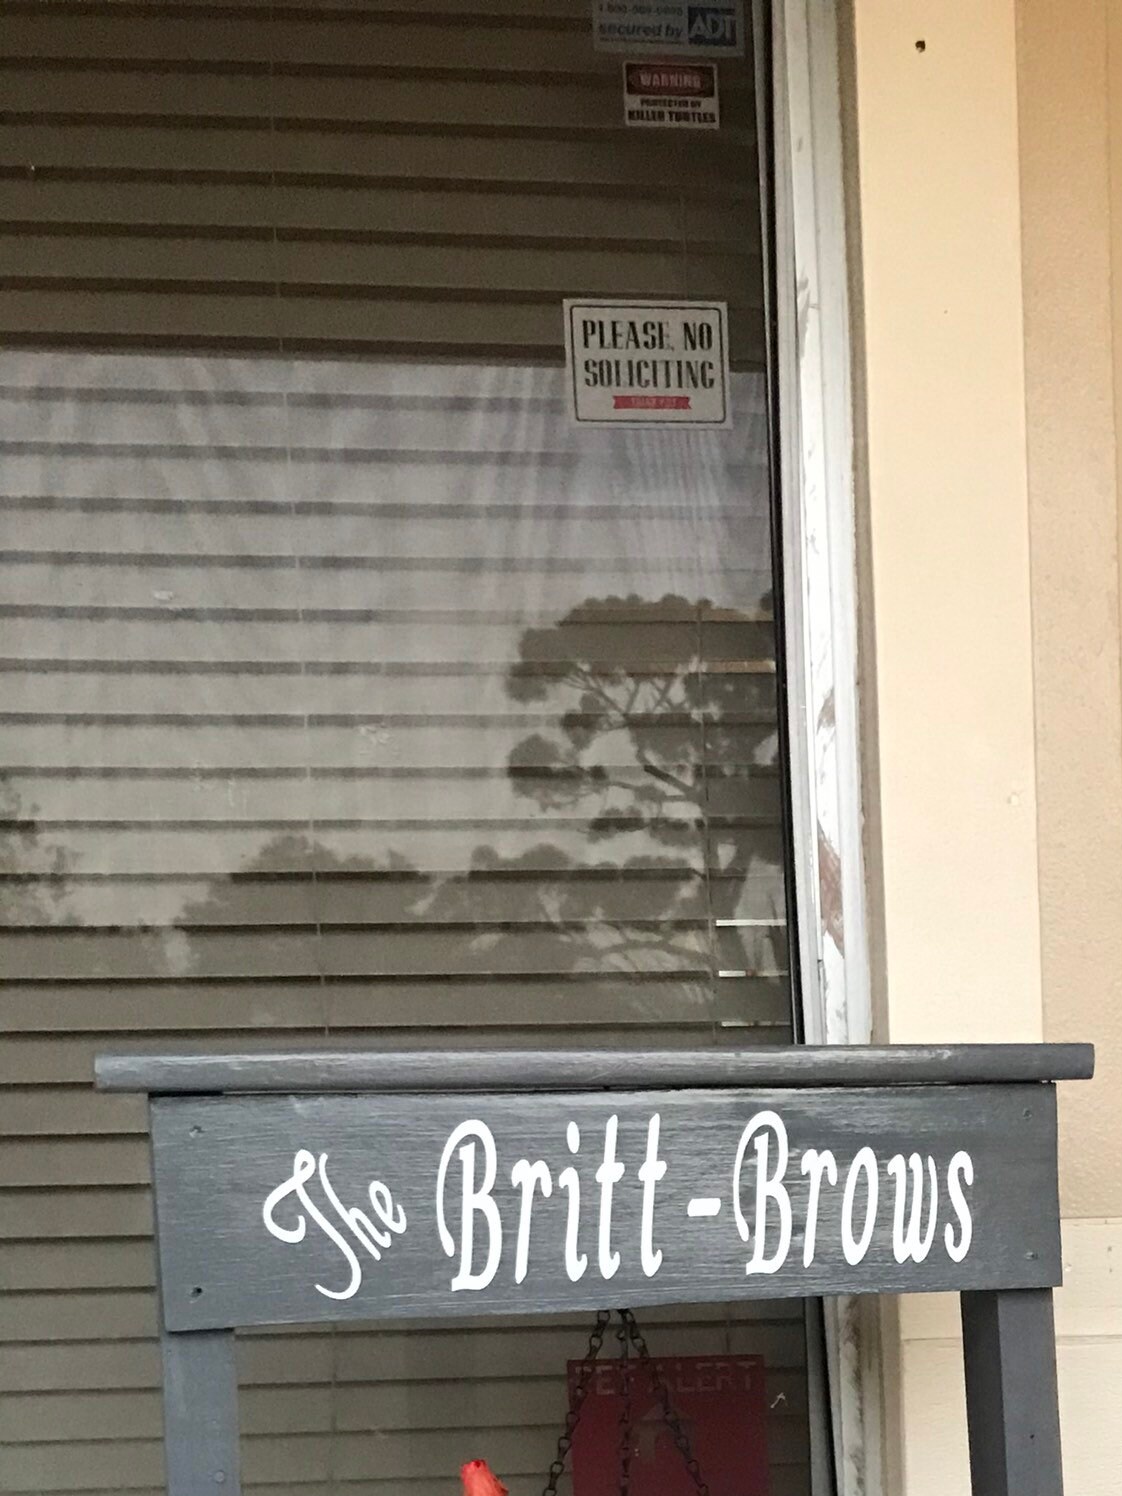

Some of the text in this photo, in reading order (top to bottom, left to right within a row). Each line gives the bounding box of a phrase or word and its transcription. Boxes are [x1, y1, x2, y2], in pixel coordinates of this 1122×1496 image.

[599, 11, 736, 40] secured by ADT
[639, 71, 702, 89] WARNING
[627, 109, 716, 123] KILLER TURTLES
[683, 322, 713, 351] NO
[584, 358, 715, 389] SOLICITING
[261, 1148, 408, 1301] The
